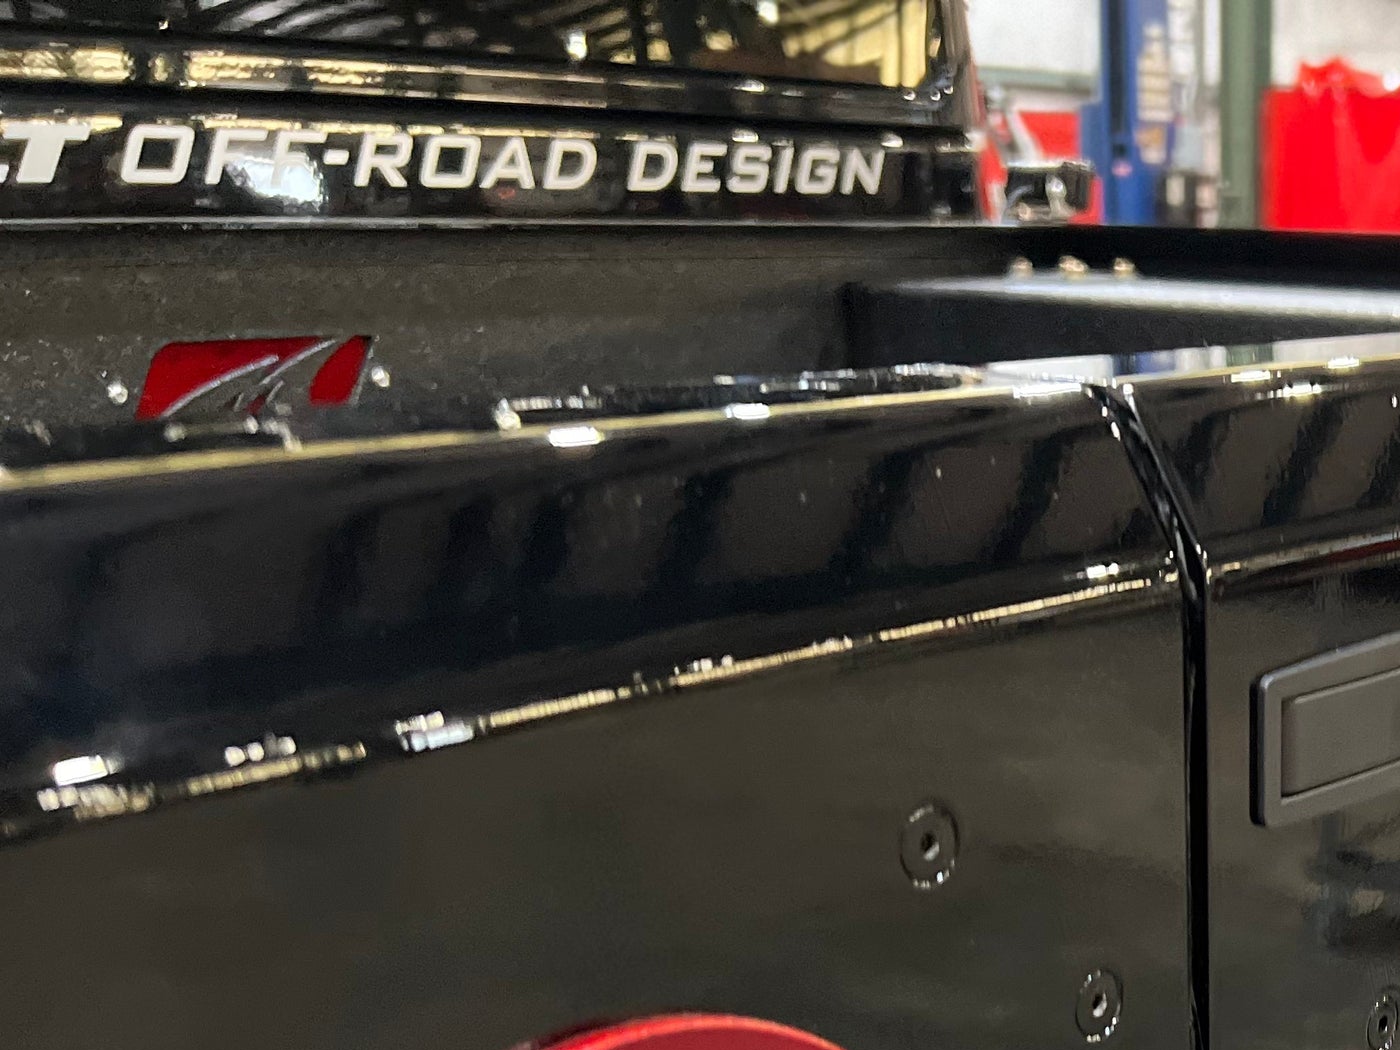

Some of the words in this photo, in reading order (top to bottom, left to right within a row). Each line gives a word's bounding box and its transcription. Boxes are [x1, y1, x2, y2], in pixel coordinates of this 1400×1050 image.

[0, 122, 92, 184] T
[120, 123, 598, 191] OFF-ROAD
[626, 139, 886, 196] DESIGN
